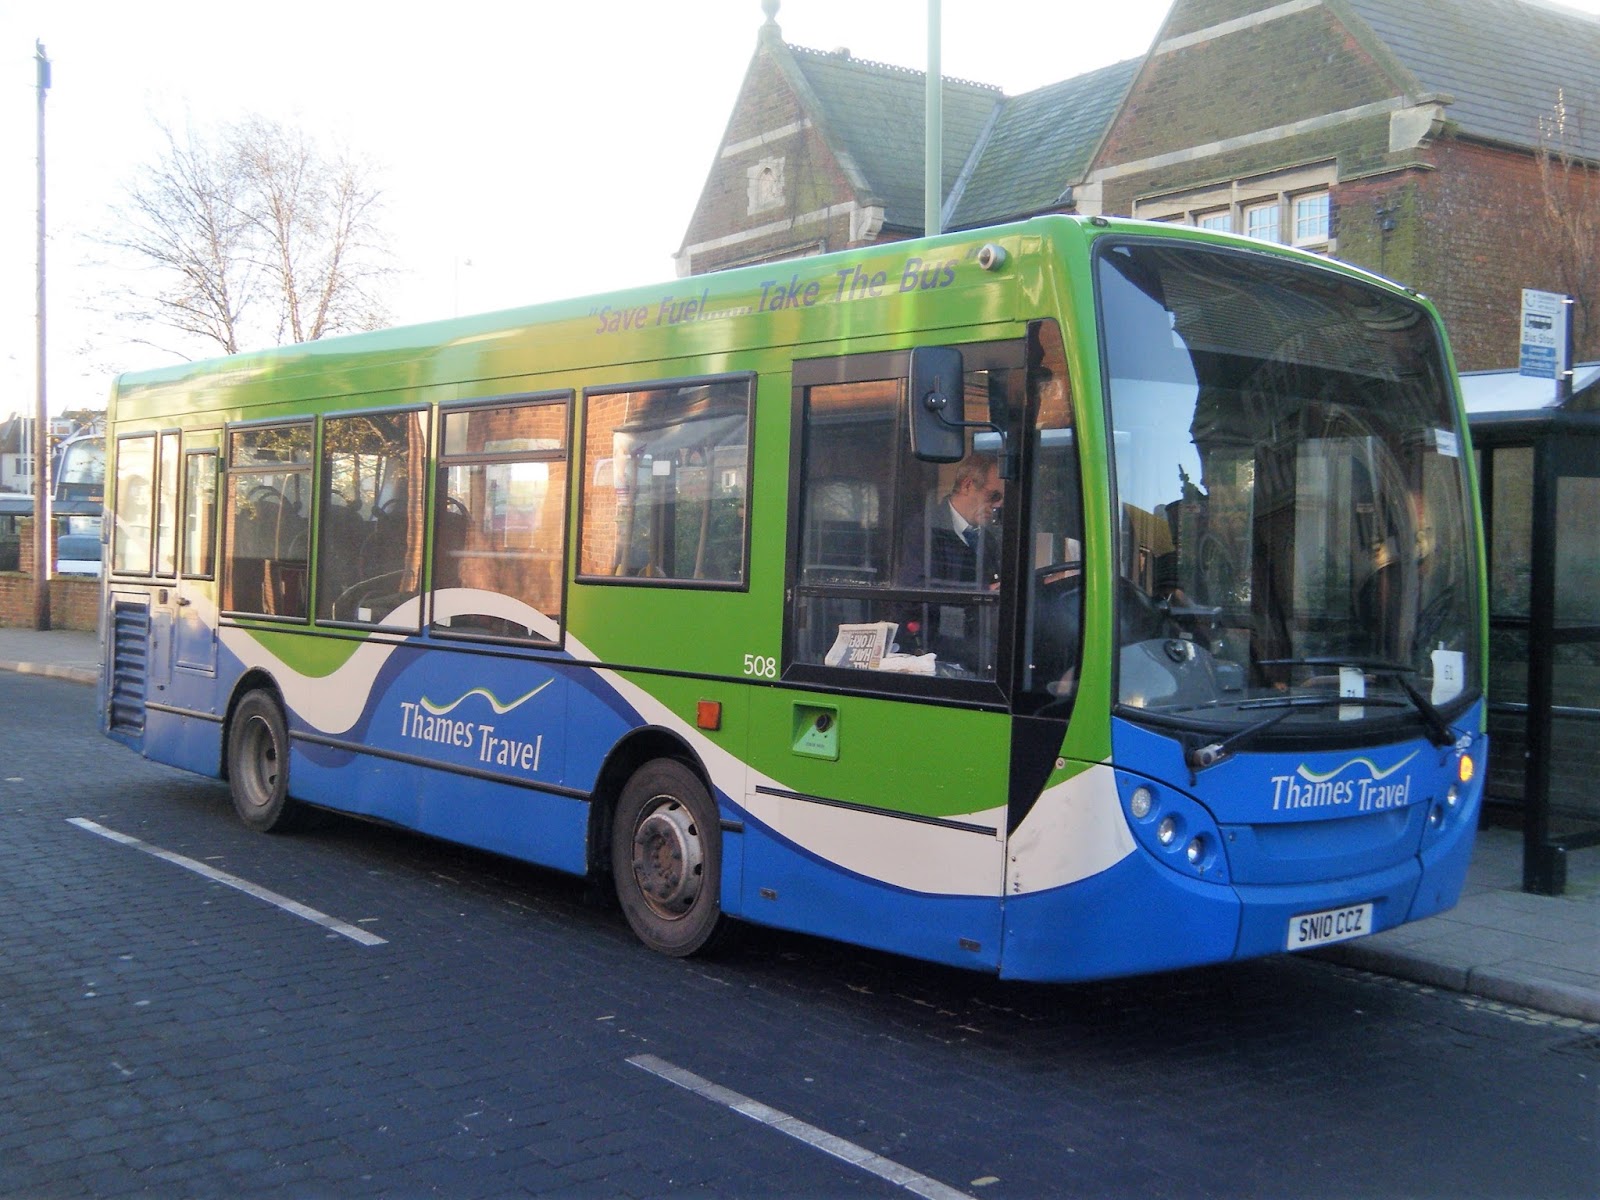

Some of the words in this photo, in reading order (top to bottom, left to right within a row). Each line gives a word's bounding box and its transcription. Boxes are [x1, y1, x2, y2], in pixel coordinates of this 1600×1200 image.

[757, 274, 821, 312] Take
[834, 265, 887, 301] The
[743, 654, 776, 678] 508
[849, 648, 872, 662] HAVE
[400, 702, 474, 748] Thames
[478, 724, 542, 772] Travel
[1271, 775, 1354, 810] Thames
[1358, 775, 1411, 811] Travel
[1298, 917, 1332, 942] SN10
[1336, 908, 1364, 934] CCZ
